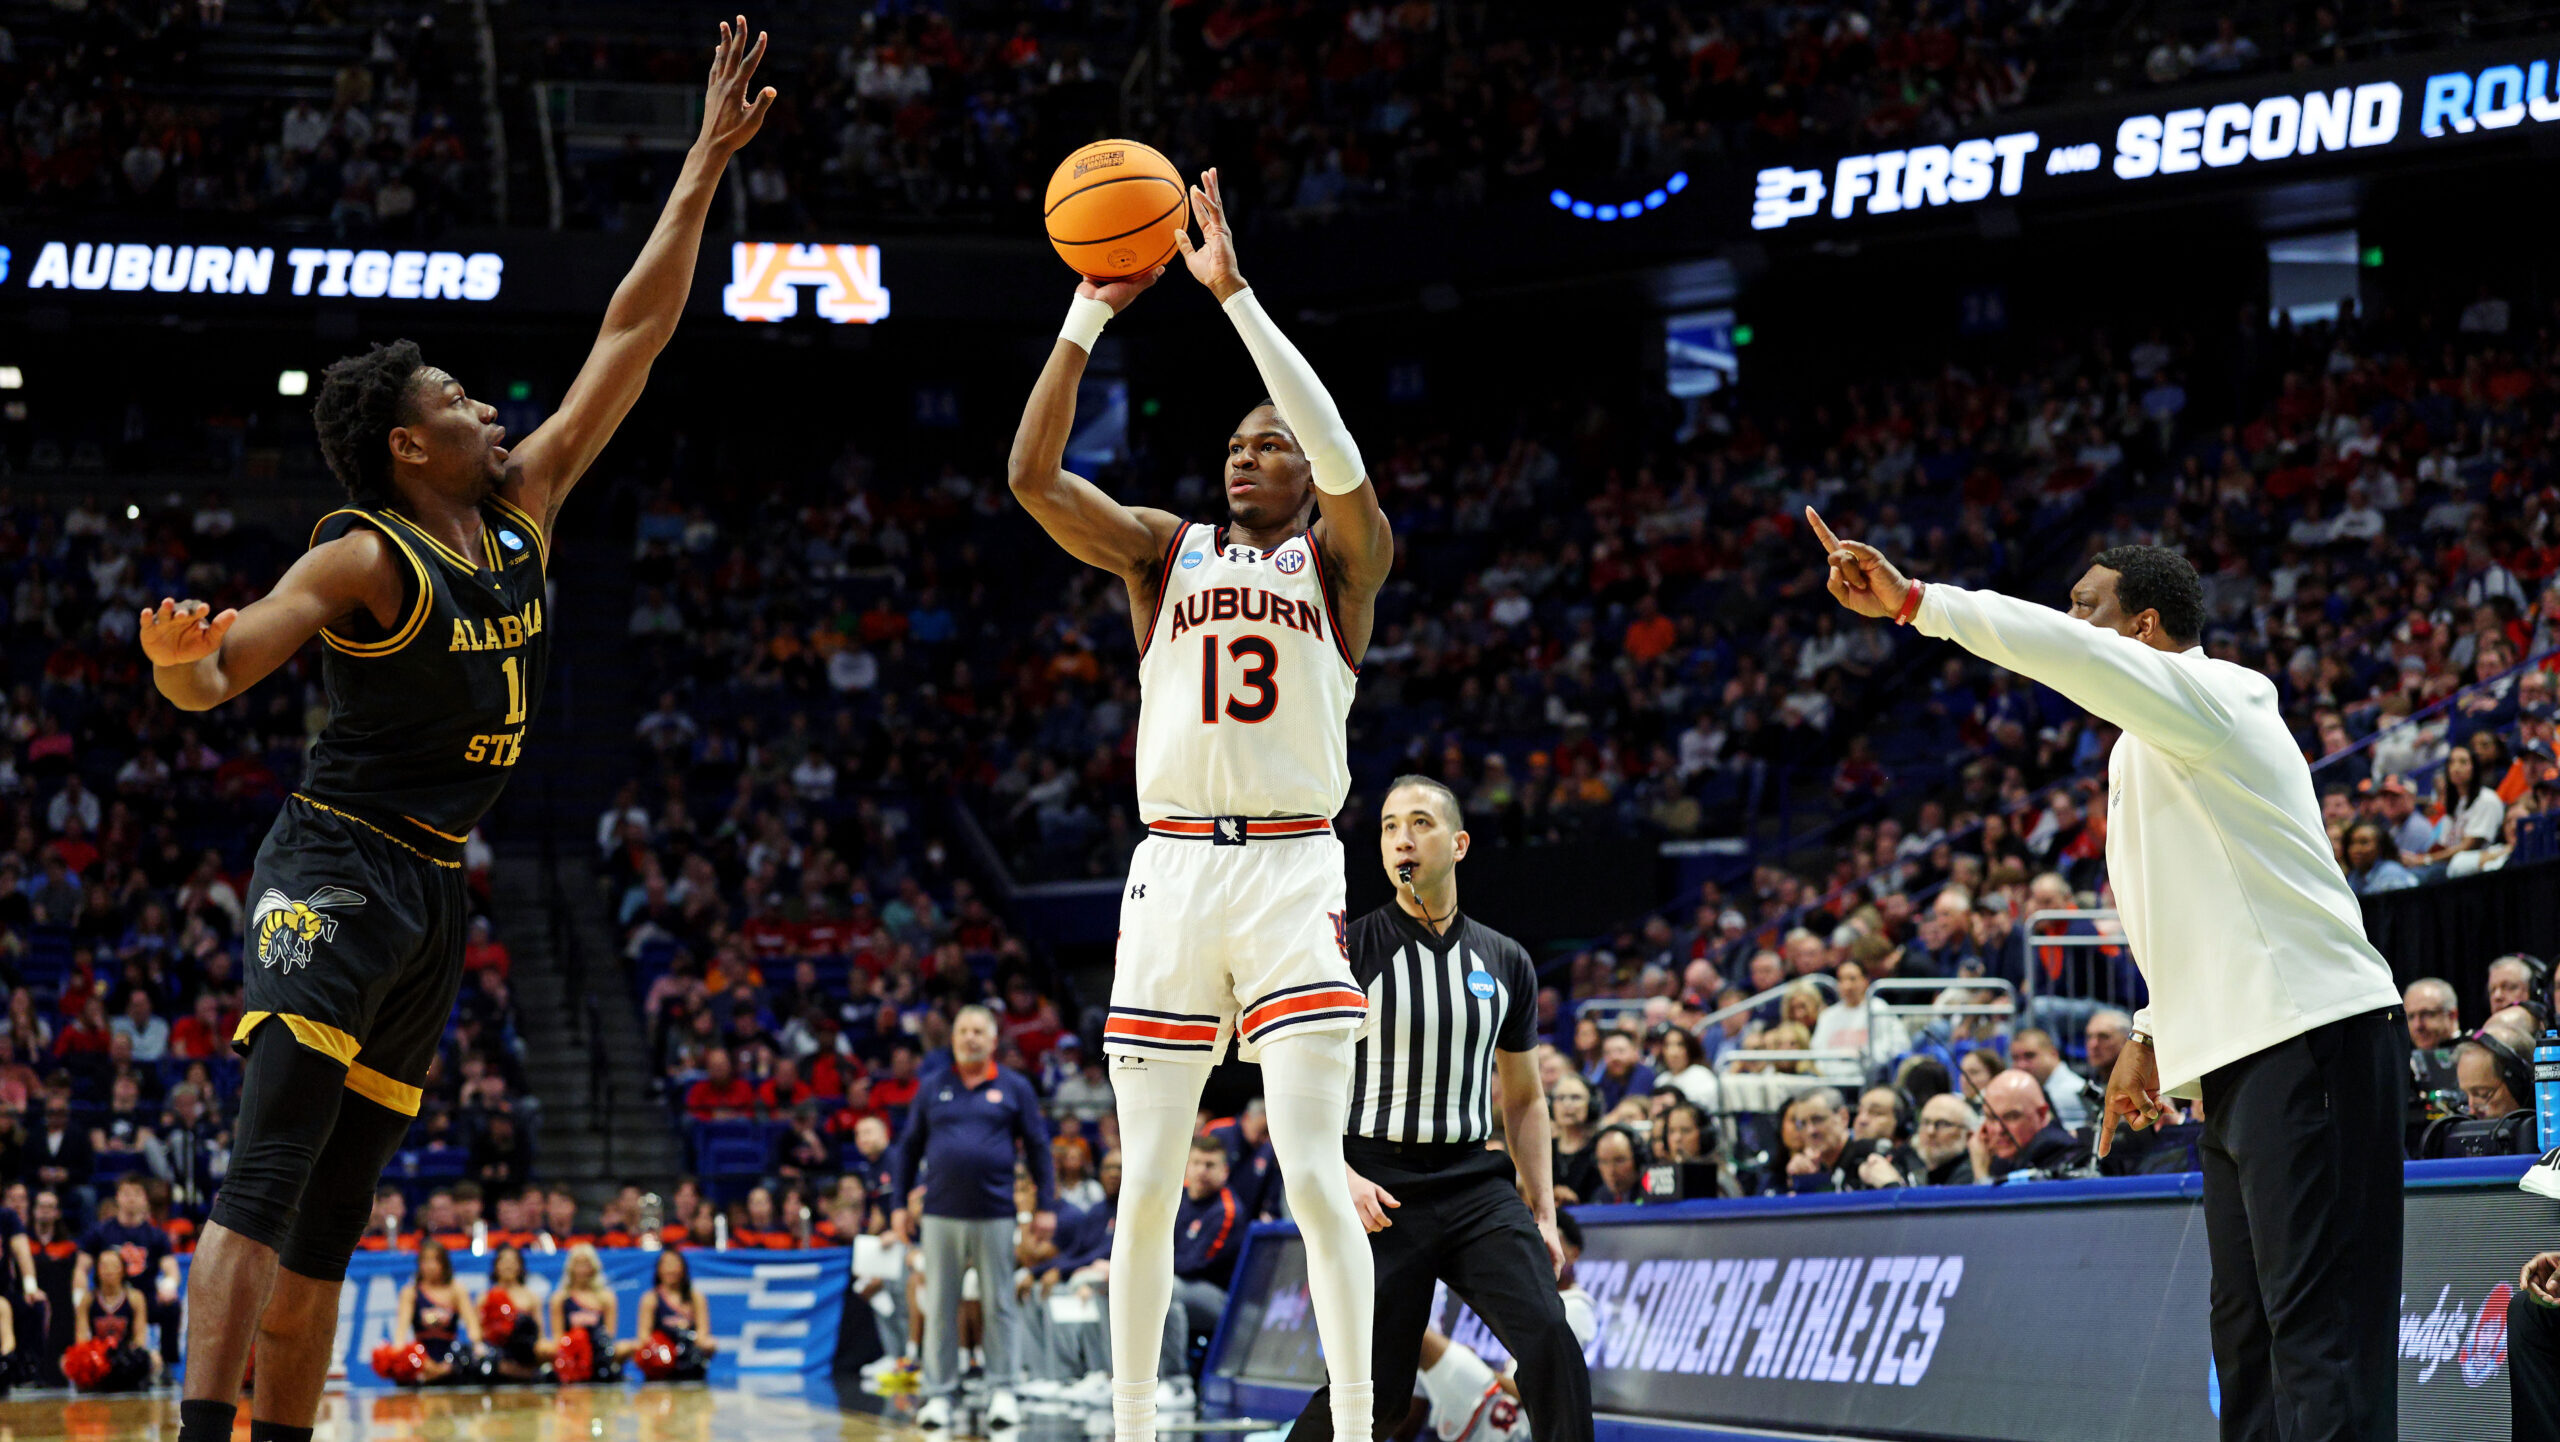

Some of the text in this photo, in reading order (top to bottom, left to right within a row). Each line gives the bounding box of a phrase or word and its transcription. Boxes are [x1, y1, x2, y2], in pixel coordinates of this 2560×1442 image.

[1831, 131, 2039, 219] FIRST
[2045, 143, 2100, 175] AND
[2113, 81, 2403, 180] SECOND
[28, 241, 274, 295] AUBURN
[288, 248, 504, 301] TIGERS
[1280, 550, 1303, 573] SEC
[1171, 586, 1325, 642] AUBURN
[1202, 634, 1279, 724] 13
